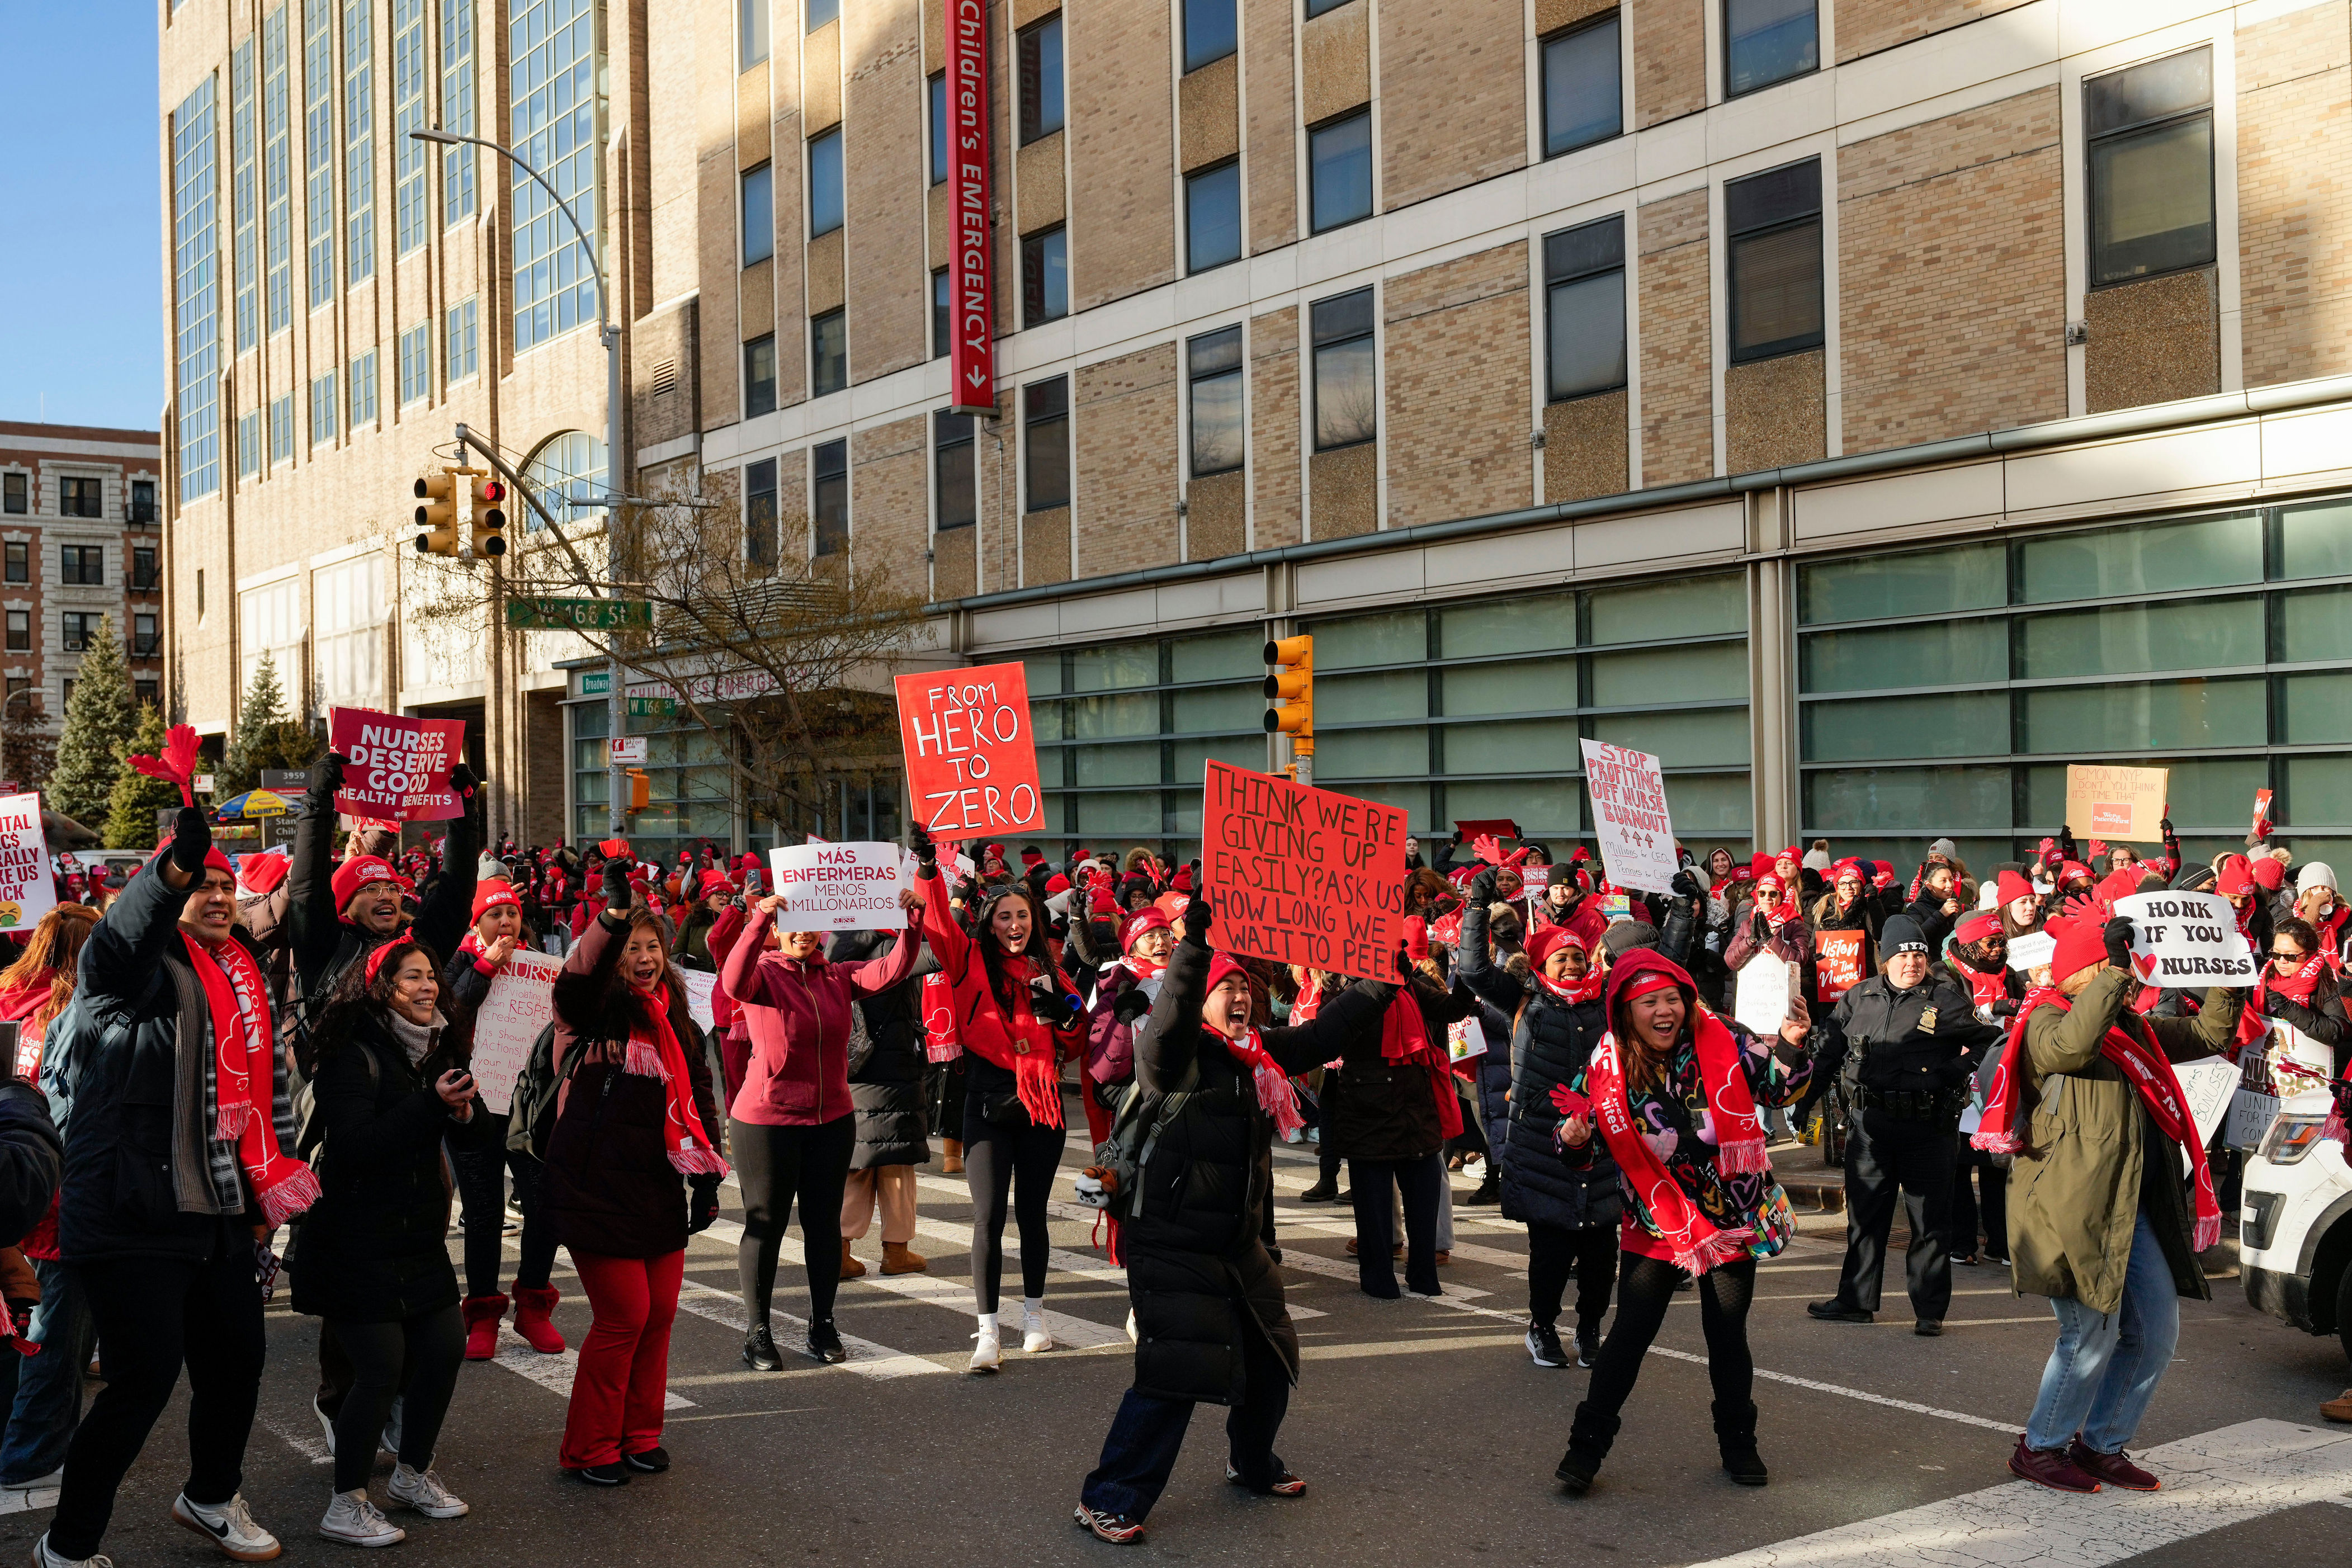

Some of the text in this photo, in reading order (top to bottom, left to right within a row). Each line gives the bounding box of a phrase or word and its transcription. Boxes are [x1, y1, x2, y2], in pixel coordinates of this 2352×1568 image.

[960, 0, 981, 150] Children's
[962, 164, 985, 355] EMERGENCY
[565, 604, 599, 625] 166
[608, 605, 627, 625] St
[585, 676, 609, 692] Broadway
[928, 681, 998, 711] FROM
[630, 698, 639, 714] W
[644, 699, 660, 714] 166
[361, 724, 445, 752] NURSES
[913, 705, 1019, 757] HERO
[350, 745, 447, 773] DESERVE
[1600, 743, 1647, 769] STOP
[946, 753, 990, 783] TO
[1587, 758, 1662, 795] PROFITING
[2075, 768, 2143, 781] C'MON NYP
[368, 769, 429, 793] GOOD
[2112, 782, 2127, 791] YOU
[2130, 782, 2157, 792] THINK
[339, 787, 396, 805] HEALTH
[402, 794, 452, 807] BENEFITS
[1591, 778, 1665, 814] OFF NURSE
[2072, 790, 2138, 801] IT'S TIME THAT
[247, 807, 284, 816] SABRETT
[925, 783, 1037, 833] ZERO
[1210, 764, 1399, 846] THINK WE'RE
[1602, 802, 1666, 834] BURNOUT
[0, 832, 20, 849] C$
[1222, 813, 1377, 871] GIVING UP
[1605, 841, 1638, 858] Millions
[818, 847, 856, 865] MÁS
[17, 865, 39, 882] US
[783, 866, 896, 883] ENFERMERAS
[1615, 859, 1642, 876] Pennies
[1654, 870, 1674, 882] CARE
[815, 884, 866, 896] MENOS
[1324, 873, 1371, 910] ASK
[1377, 882, 1404, 914] US
[792, 896, 894, 911] MILLONARIO$
[2146, 901, 2213, 919] HONK
[1211, 885, 1385, 944] HOW LONG WE
[2144, 925, 2223, 943] IF YOU
[1224, 920, 1397, 985] WAIT TO PEE!
[2019, 946, 2046, 957] victimized
[498, 961, 561, 984] NURSE
[541, 960, 552, 969] York
[2161, 957, 2251, 975] NURSES
[495, 975, 554, 989] ASSOCIATI
[1820, 964, 1862, 988] Nurses!
[488, 983, 508, 996] NYP
[510, 989, 541, 1004] violating
[485, 999, 504, 1007] own
[1461, 1016, 1472, 1027] US
[485, 1028, 493, 1037] is
[1448, 1028, 1467, 1043] SICK
[26, 1037, 42, 1049] State
[480, 1038, 523, 1057] Actions!
[476, 1058, 501, 1069] your
[2261, 1049, 2280, 1061] TH
[475, 1069, 507, 1086] Settling
[2184, 1069, 2202, 1099] ights
[2193, 1062, 2230, 1122] BONUSES
[2239, 1110, 2260, 1123] FOR
